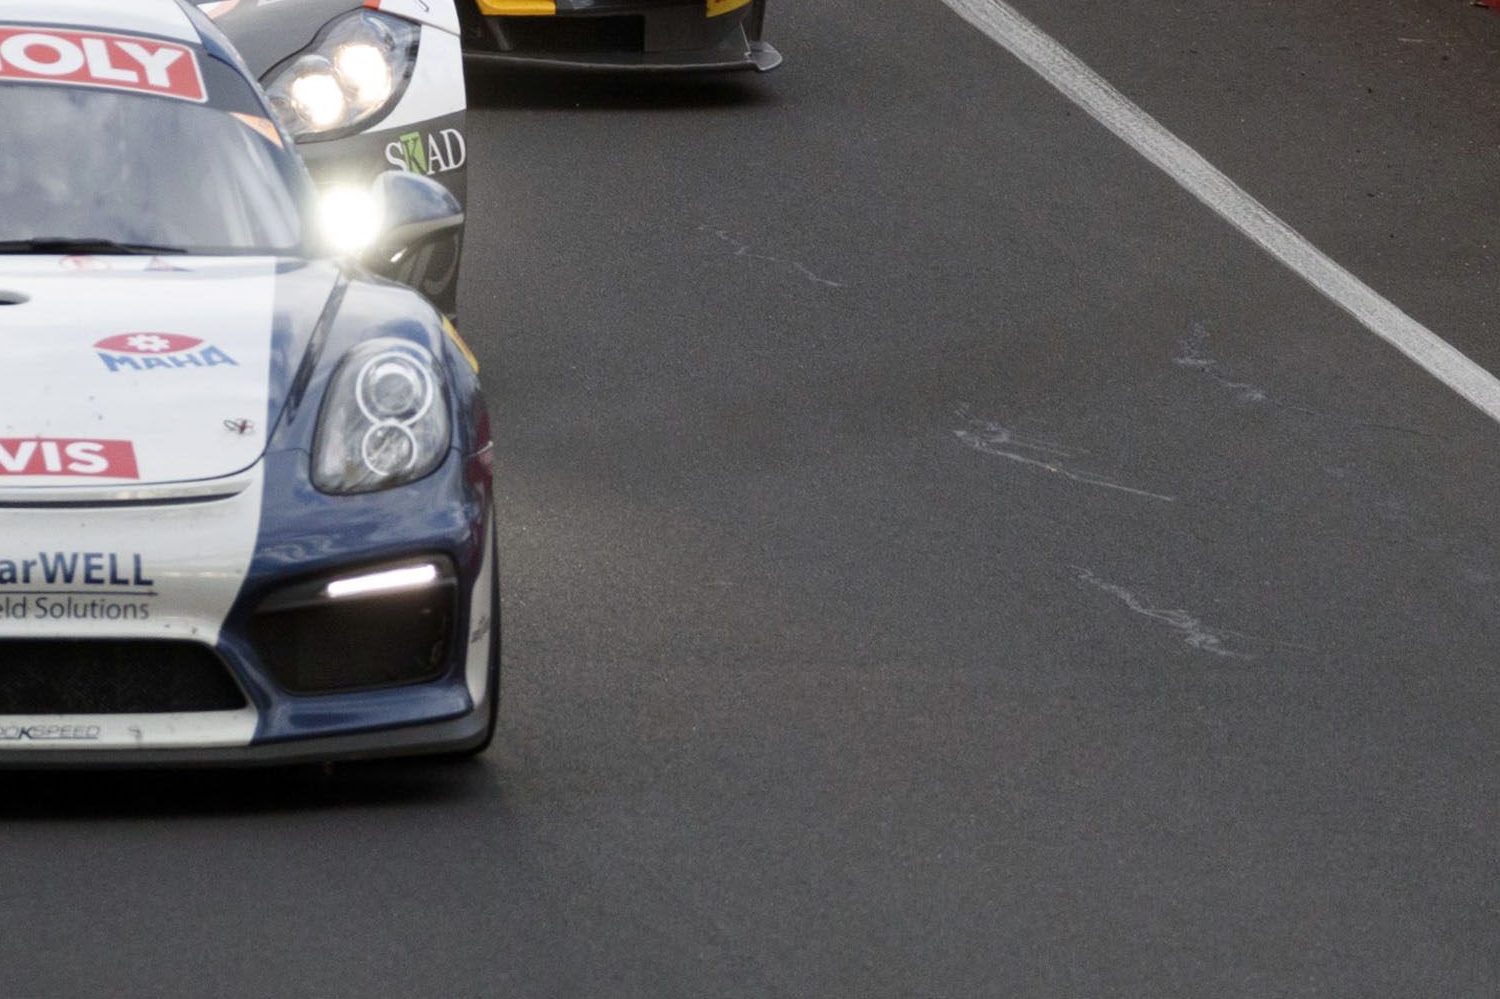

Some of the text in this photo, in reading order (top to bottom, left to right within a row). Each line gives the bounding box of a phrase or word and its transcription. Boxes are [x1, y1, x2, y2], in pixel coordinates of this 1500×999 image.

[385, 128, 467, 177] SKAD
[96, 344, 240, 373] MAHA
[34, 596, 150, 620] Solutions
